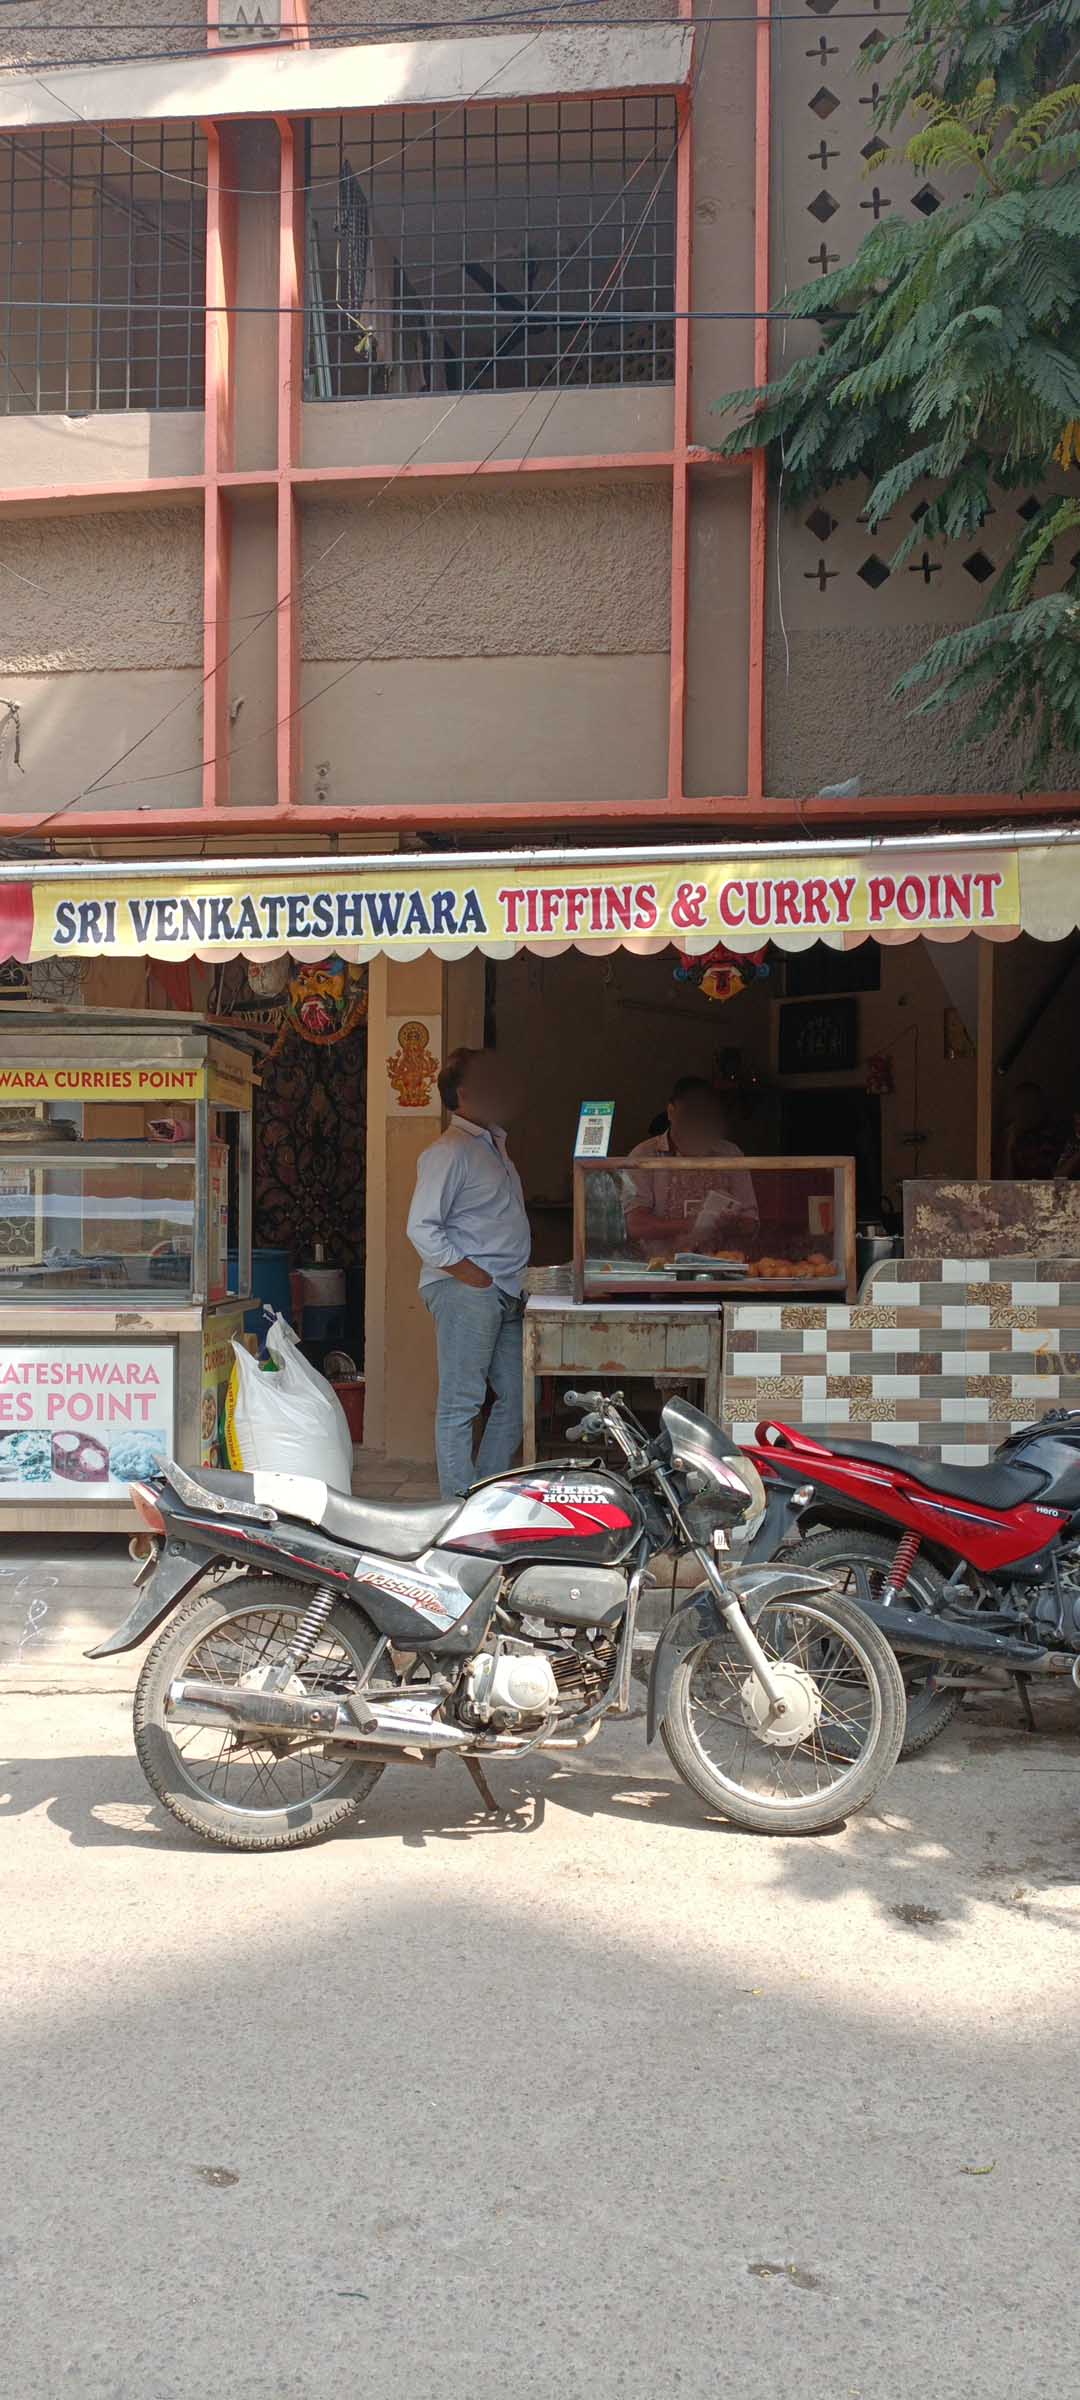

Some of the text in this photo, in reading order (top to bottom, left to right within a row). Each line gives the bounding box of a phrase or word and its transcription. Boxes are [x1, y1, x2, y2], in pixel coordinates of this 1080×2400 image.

[53, 873, 1002, 944] SRI VENKATESHWARA TIFFINS & CURRY POINT
[54, 1071, 132, 1088] CURRIES
[138, 1071, 198, 1088] POINT
[0, 1363, 160, 1385] ATESHWARA
[47, 1392, 157, 1422] POINT
[550, 1485, 605, 1495] HERO
[543, 1494, 610, 1504] HONDA
[1036, 1506, 1059, 1517] Hero
